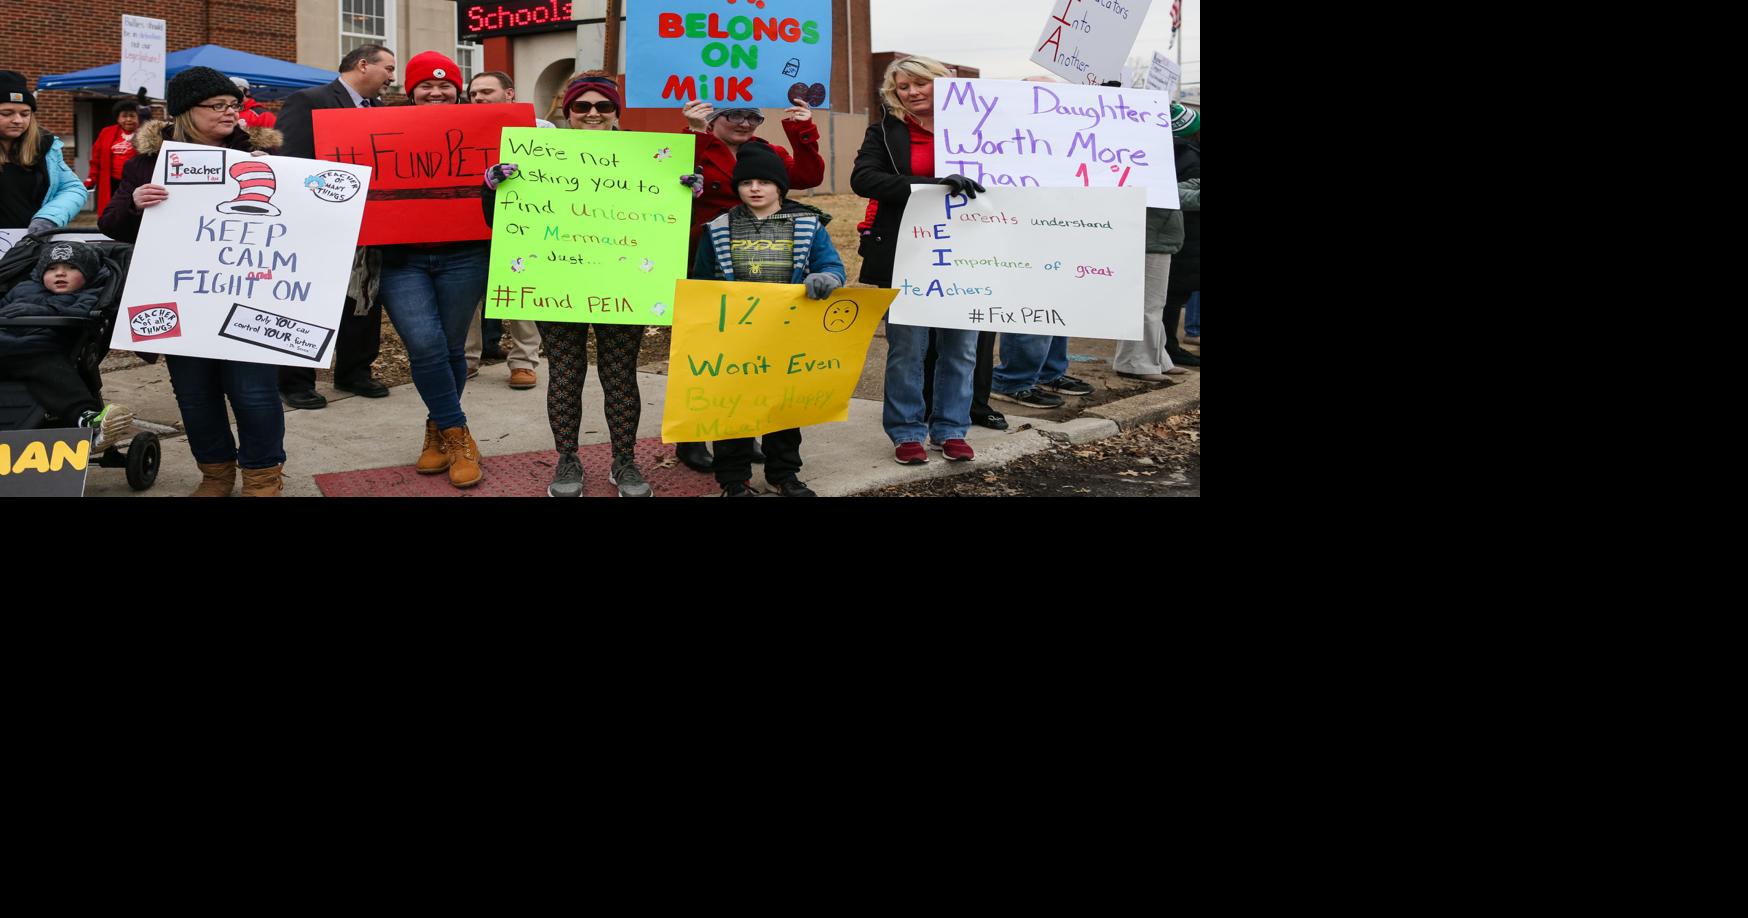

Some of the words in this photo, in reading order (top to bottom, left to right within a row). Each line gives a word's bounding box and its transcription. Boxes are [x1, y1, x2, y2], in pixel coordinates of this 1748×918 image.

[468, 0, 572, 31] Schools
[658, 12, 820, 44] BELONGS
[701, 41, 758, 70] ON
[1038, 25, 1090, 72] Another
[942, 81, 998, 135] My
[943, 127, 1052, 156] Worth
[1067, 131, 1149, 167] More
[170, 163, 222, 179] Teacher
[580, 152, 620, 168] not
[509, 168, 580, 192] asking
[590, 177, 631, 193] you
[637, 179, 660, 195] to
[944, 160, 1040, 188] Than
[317, 187, 346, 201] THINGS
[500, 190, 555, 214] find
[571, 202, 677, 224] Unicorns
[944, 193, 1019, 225] Parents
[1030, 216, 1113, 230] understand
[195, 215, 287, 247] KEEP
[506, 223, 530, 236] or
[543, 225, 638, 247] Mermaids
[912, 223, 951, 240] thE
[218, 246, 297, 273] CALM
[932, 248, 1032, 270] Importance
[1044, 261, 1062, 271] of
[1074, 264, 1115, 279] great
[247, 269, 273, 280] and
[272, 279, 312, 301] ON
[490, 285, 573, 309] #Fund
[587, 295, 634, 313] PEIA
[900, 278, 993, 297] teAchers
[132, 309, 176, 325] TEACHER
[139, 322, 172, 335] THINGS
[154, 316, 165, 325] all
[275, 316, 297, 330] YOU
[1020, 307, 1067, 327] PEIA
[233, 321, 261, 333] control
[263, 327, 292, 342] YOUR
[786, 353, 841, 375] Even
[686, 386, 744, 418] Buy
[753, 394, 768, 407] a
[779, 385, 836, 412] Happy
